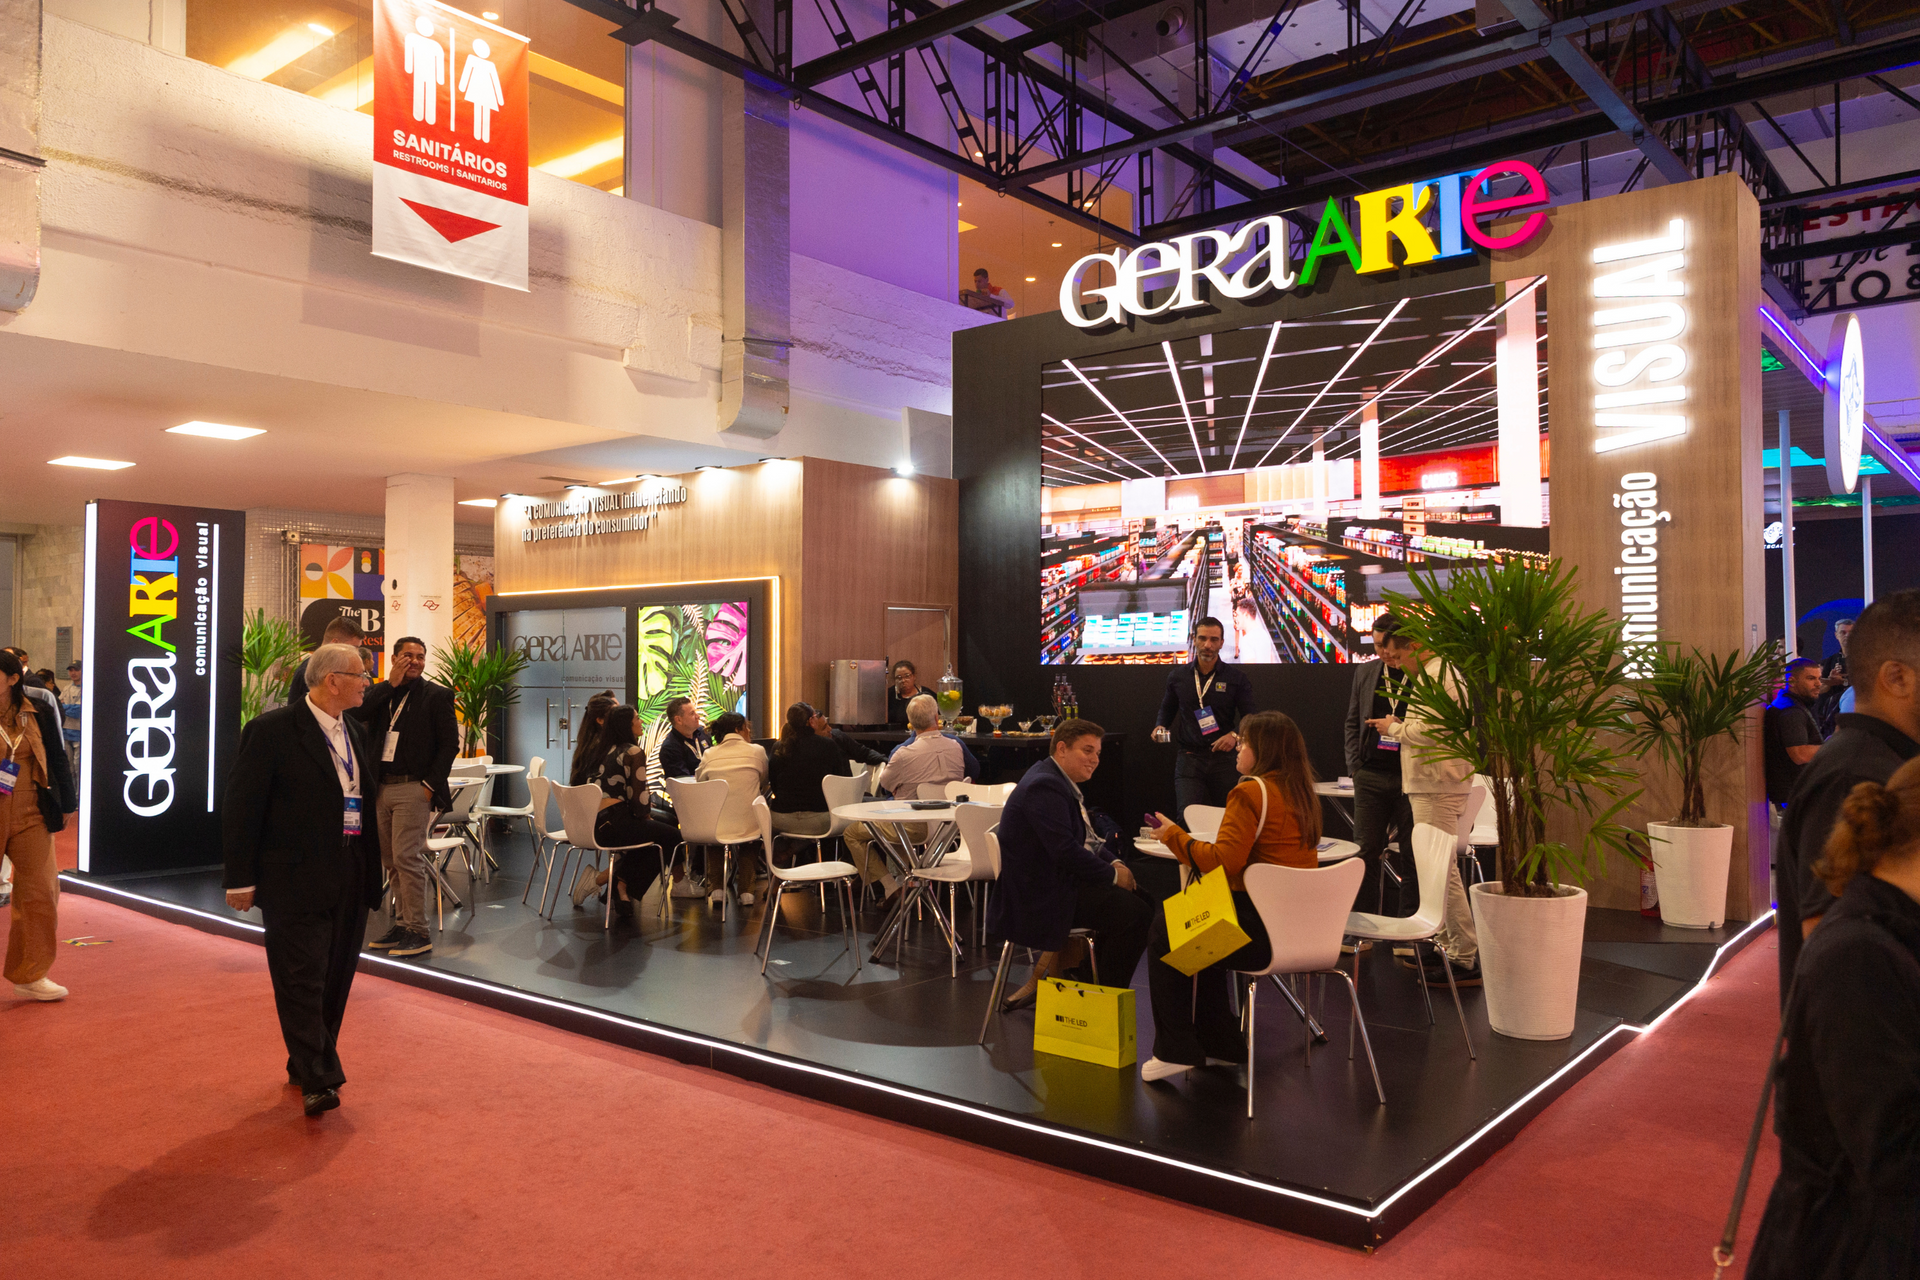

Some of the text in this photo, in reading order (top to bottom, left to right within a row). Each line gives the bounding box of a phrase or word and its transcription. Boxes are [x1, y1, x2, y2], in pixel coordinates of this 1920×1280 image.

[392, 129, 508, 178] SANITÁRIOS
[393, 149, 508, 191] RESTROOMS SANITARIOS
[1593, 218, 1686, 454] VISUAL
[533, 496, 590, 520] COMUNICAÇÃO
[591, 494, 620, 513] VISUAL
[621, 486, 687, 509] influenciando
[522, 528, 532, 542] na
[533, 520, 582, 543] preferência
[583, 519, 594, 536] do
[595, 514, 649, 533] consumidor
[194, 522, 210, 676] comunicação visual
[338, 605, 385, 632] The B
[362, 634, 385, 646] Rest
[561, 674, 626, 683] comunicação visual
[1190, 910, 1211, 926] THE LED
[1064, 1016, 1076, 1025] THE
[1076, 1019, 1088, 1028] LED
